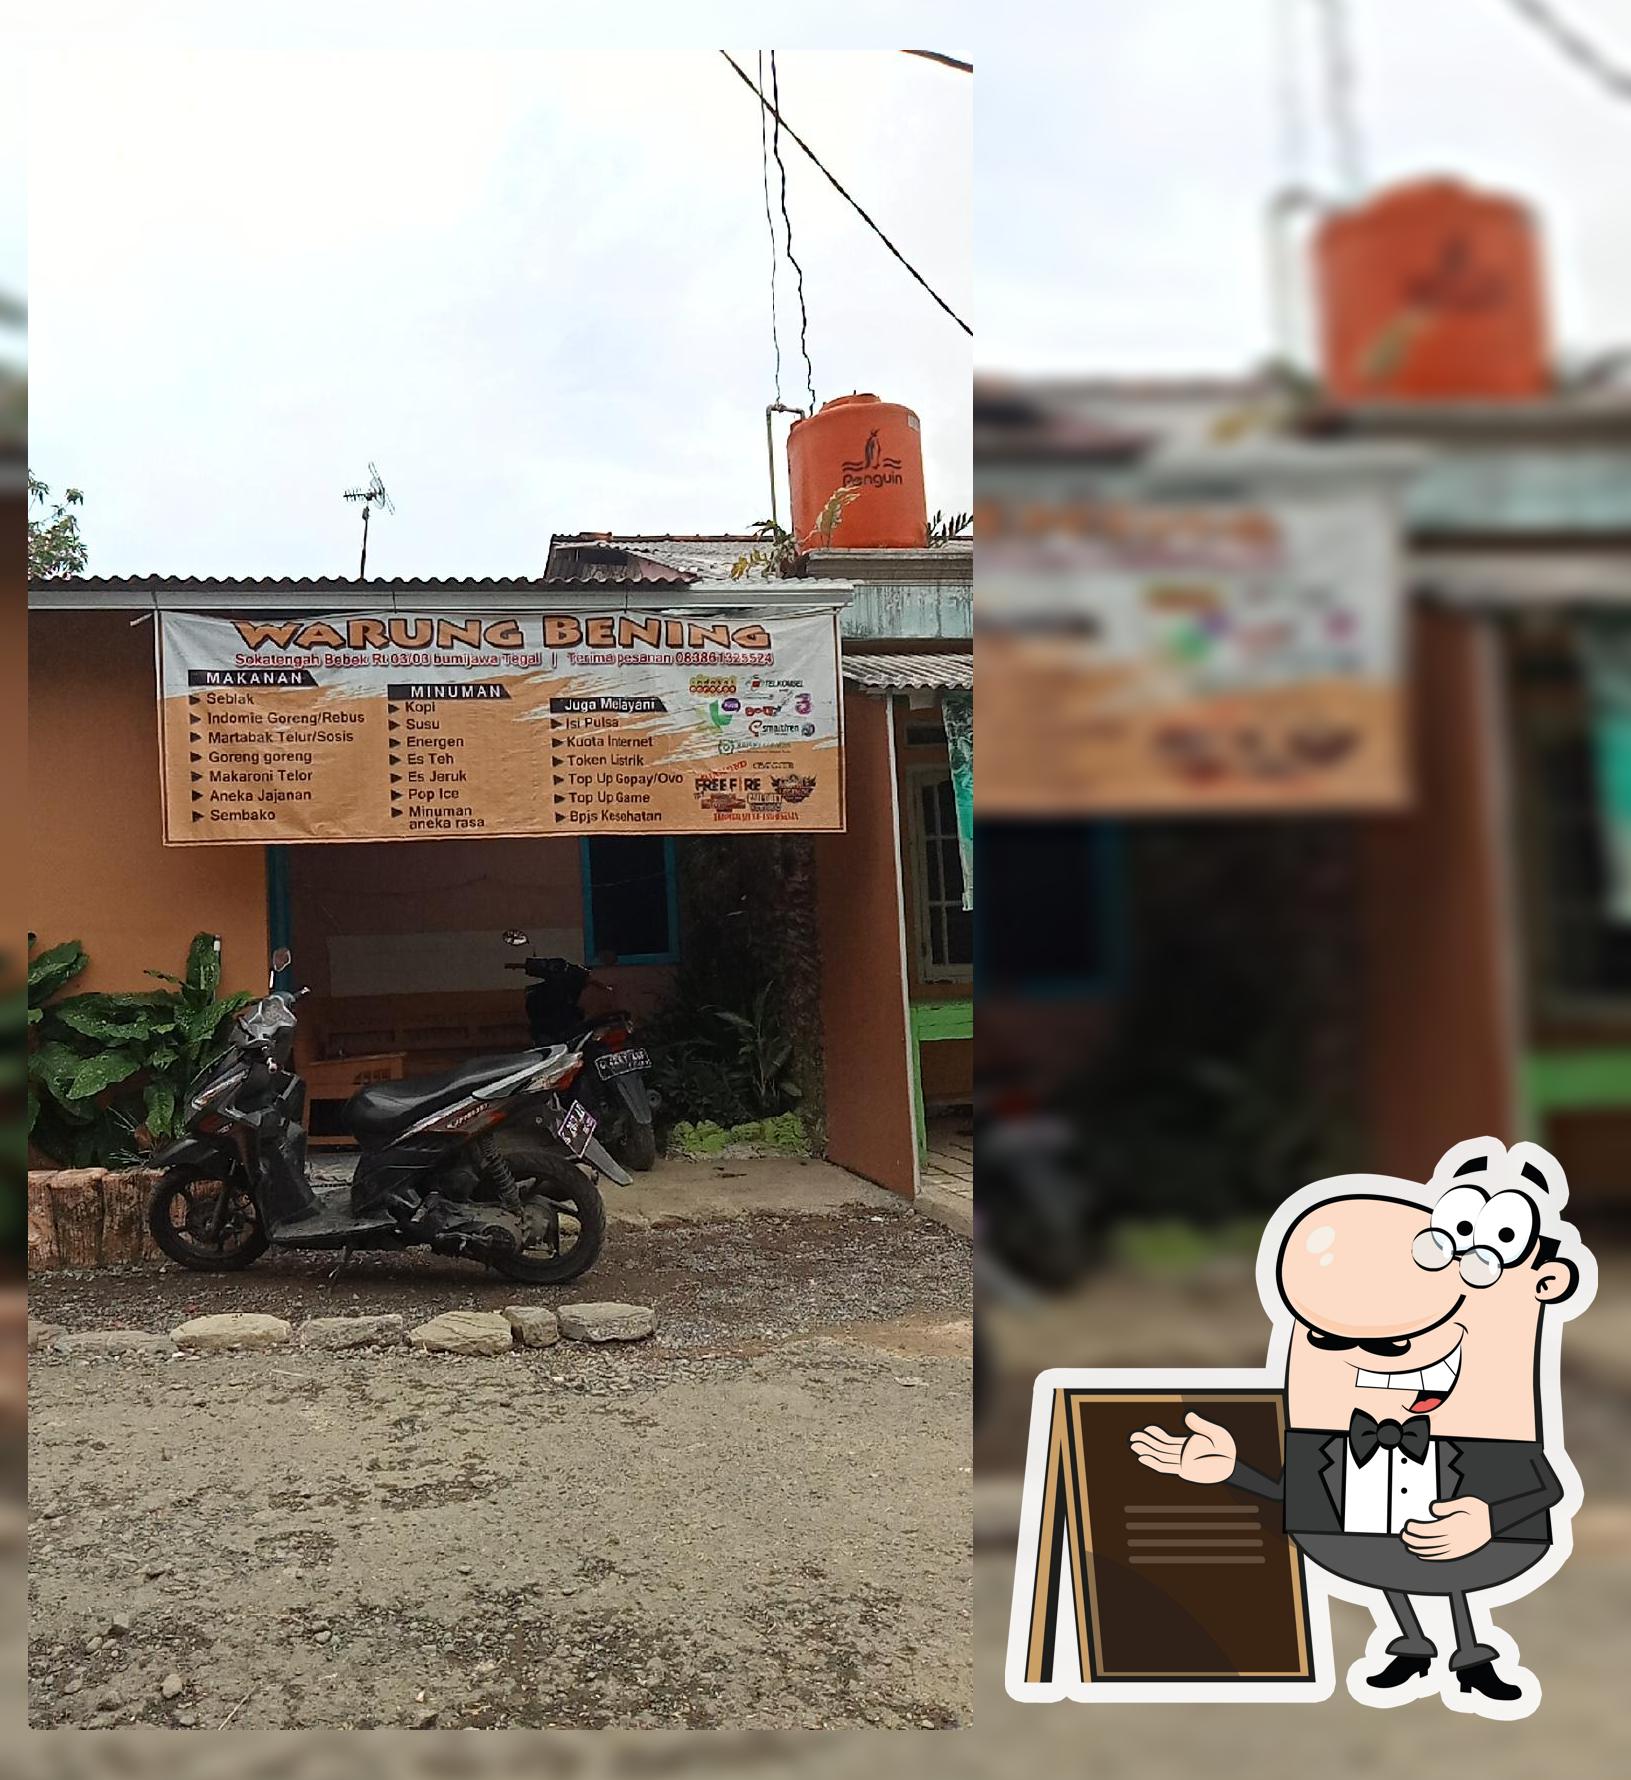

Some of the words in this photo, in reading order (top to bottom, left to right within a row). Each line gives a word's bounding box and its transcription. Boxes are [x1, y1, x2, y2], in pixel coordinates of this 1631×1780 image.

[842, 471, 903, 488] Penguin
[230, 617, 525, 650] WARUNG
[542, 614, 772, 650] BENING
[324, 653, 368, 666] Bebek
[433, 652, 499, 669] bumijawa
[502, 652, 542, 668] Tegal
[566, 652, 614, 666] Terima
[617, 652, 673, 668] pesanan
[206, 672, 302, 684] MAKANAN
[206, 691, 254, 705] Seblak
[411, 685, 501, 698] MINUMAN
[405, 701, 436, 715] Kopi
[565, 699, 596, 713] Juga
[600, 697, 655, 713] Melayani
[207, 712, 263, 725] Indomie
[267, 710, 365, 726] Goreng/Rebus
[406, 718, 440, 730] Susu
[566, 717, 581, 729] Isi
[584, 716, 619, 728] Pulsa
[208, 730, 273, 744] Martabak
[278, 730, 354, 743] Telur/Sosis
[406, 736, 464, 750] Energen
[567, 736, 604, 748] Kuota
[608, 735, 653, 748] Internet
[208, 751, 259, 765] Goreng
[263, 752, 312, 765] goreng
[407, 753, 424, 765] Es
[428, 753, 454, 765] Teh
[567, 754, 607, 766] Token
[611, 754, 644, 766] Listrik
[209, 769, 273, 783] Makaroni
[277, 769, 313, 782] Telor
[408, 771, 424, 783] Es
[429, 770, 467, 782] Jeruk
[568, 773, 593, 787] Top
[597, 772, 613, 787] Up
[616, 772, 684, 787] Gopay/Ovo
[209, 789, 253, 802] Aneka
[257, 788, 312, 804] Jajanan
[408, 788, 435, 802] Pop
[439, 788, 459, 800] Ice
[568, 792, 593, 806] Top
[597, 790, 613, 805] Up
[616, 791, 651, 804] Game
[210, 809, 276, 822] Sembako
[409, 805, 472, 818] Minuman
[570, 810, 598, 824] Bpjs
[601, 809, 662, 822] Kesehatan
[409, 817, 451, 830] aneka
[456, 818, 485, 829] rasa
